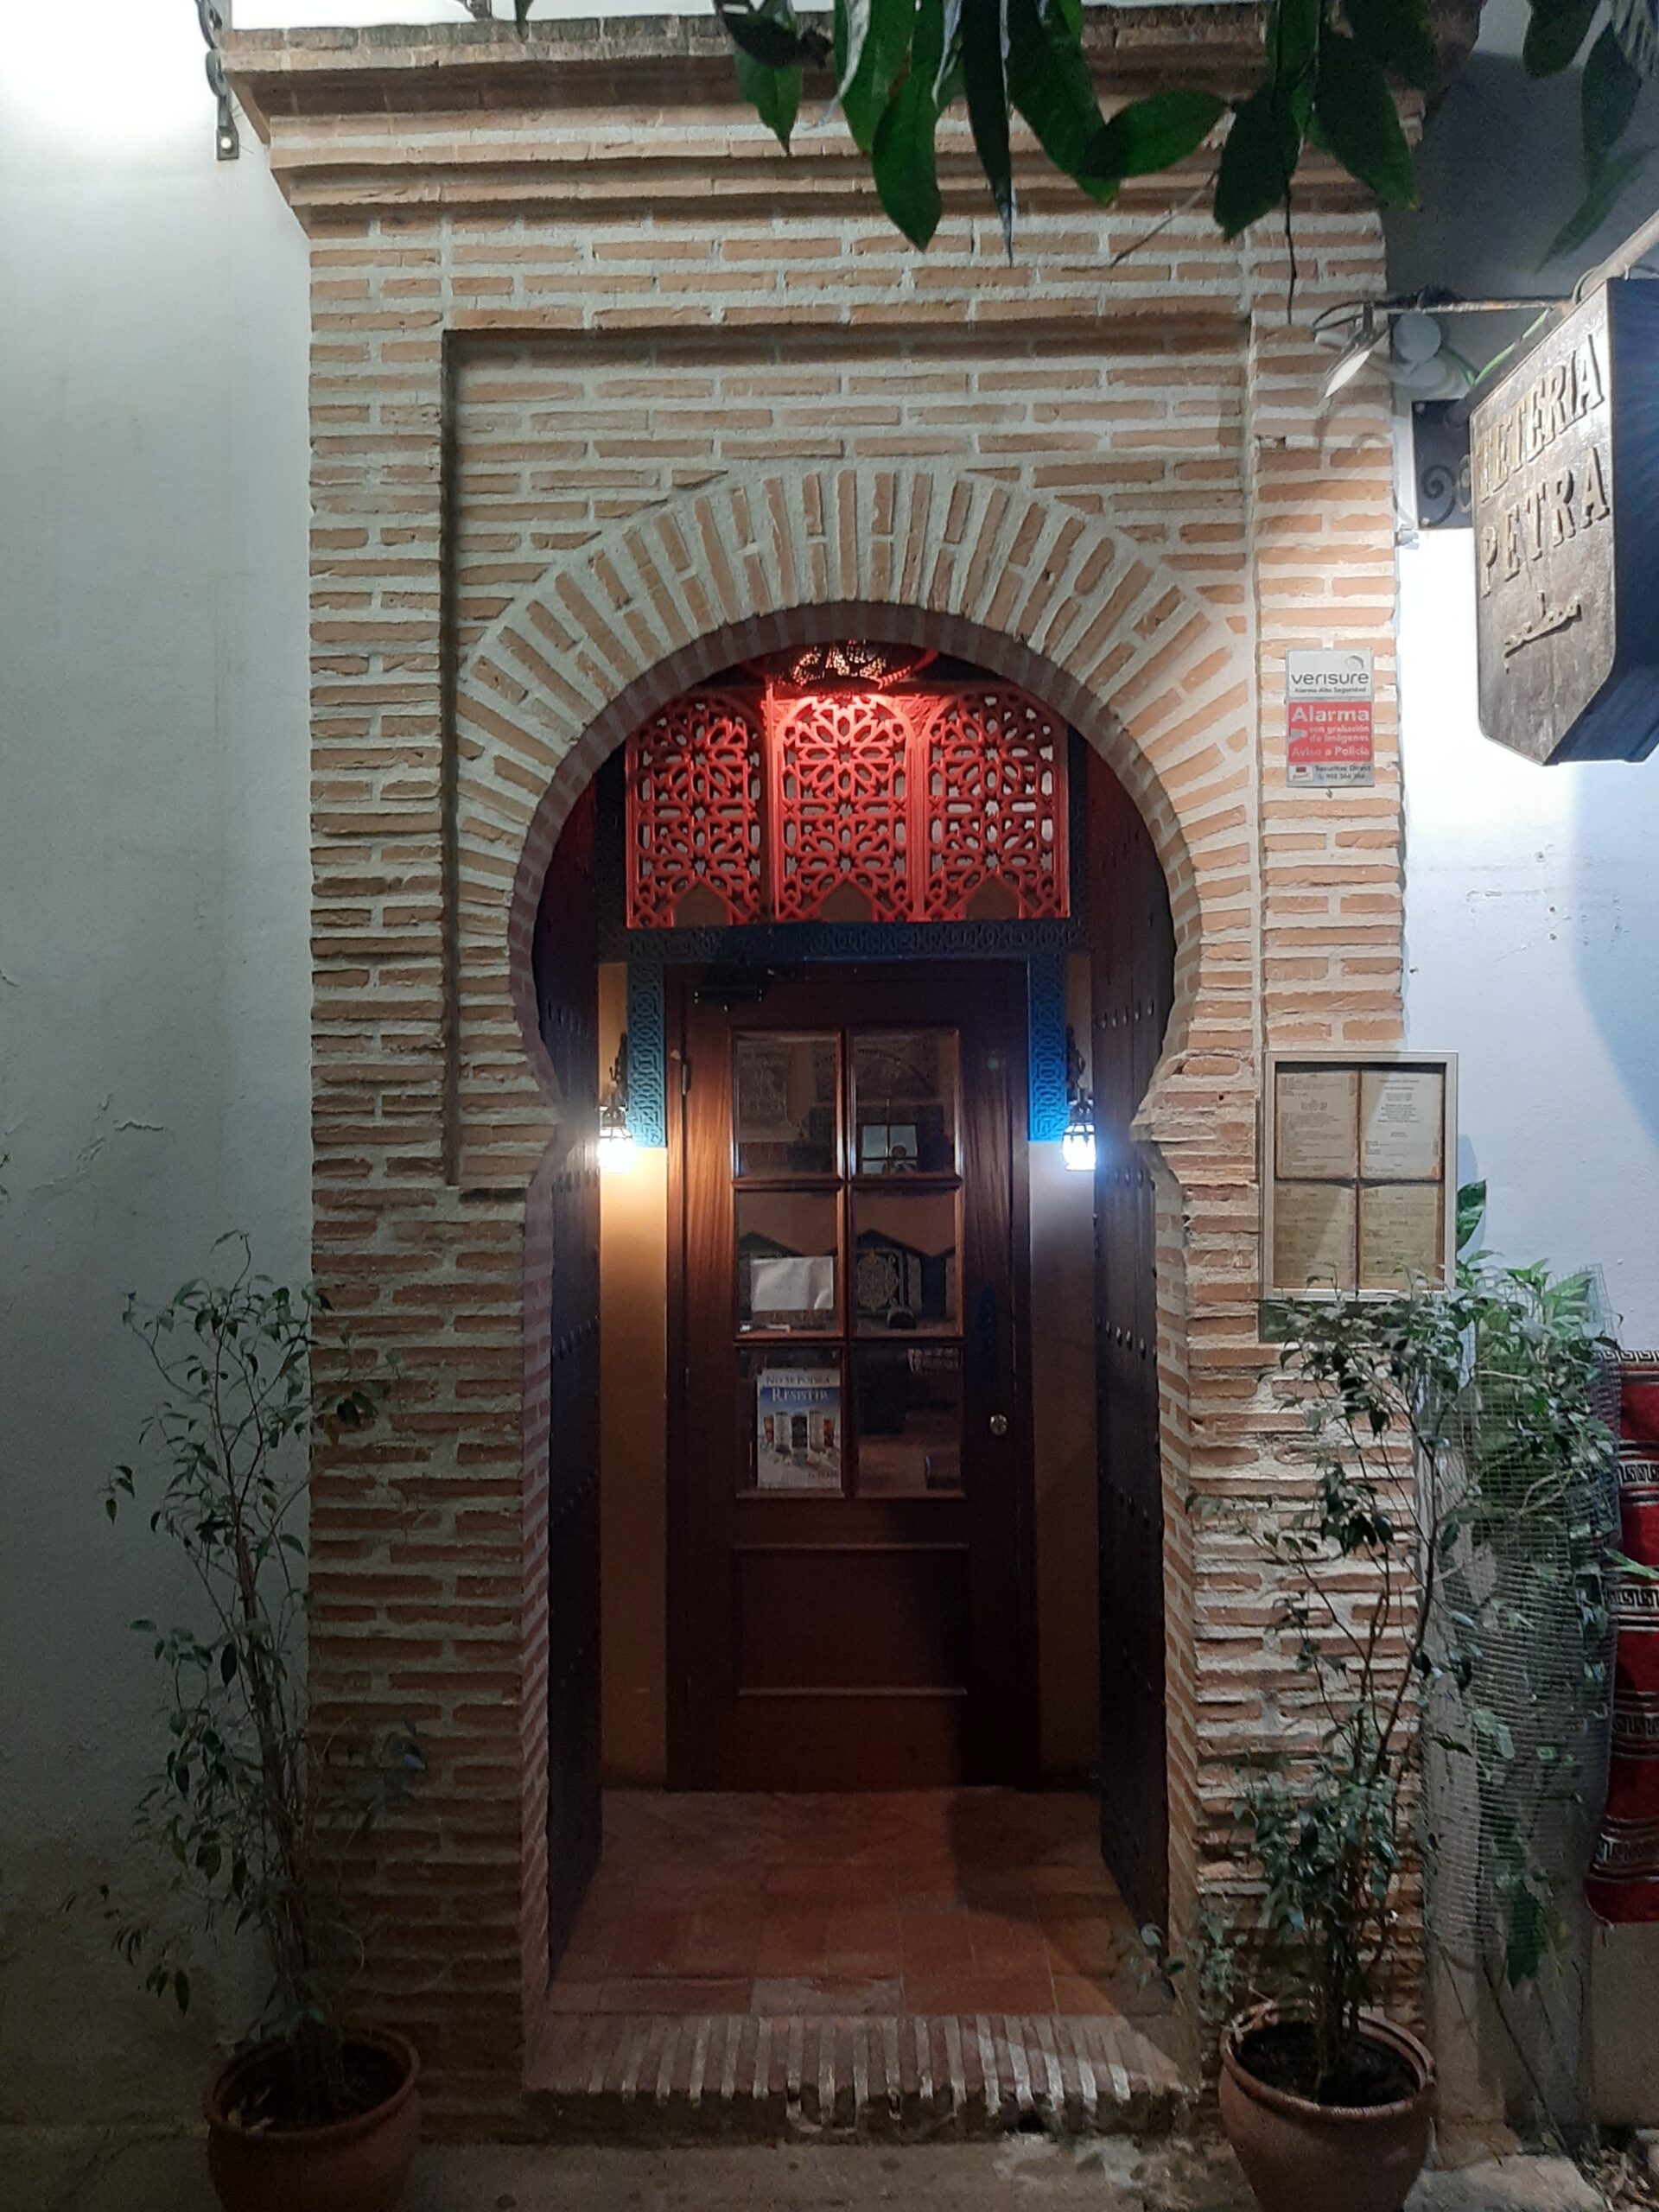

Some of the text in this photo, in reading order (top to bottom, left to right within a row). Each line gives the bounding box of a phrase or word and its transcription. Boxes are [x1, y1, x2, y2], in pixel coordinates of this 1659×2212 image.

[1478, 447, 1611, 599] PETRA
[1291, 672, 1370, 685] verisure
[1291, 704, 1370, 722] Alarma
[1292, 747, 1322, 757] Aviso
